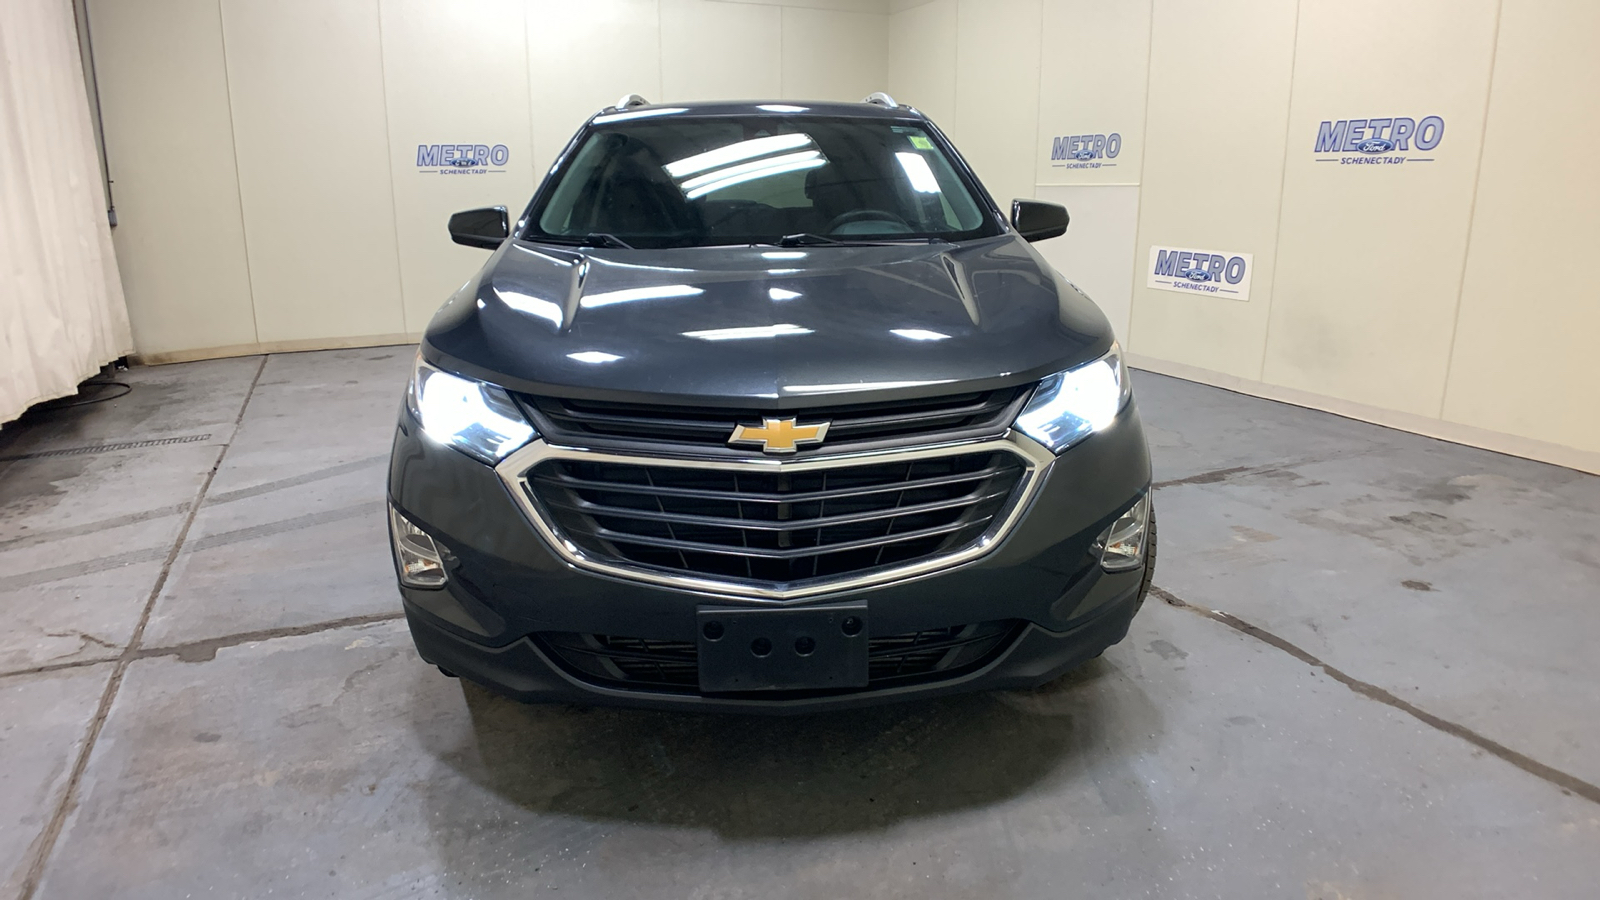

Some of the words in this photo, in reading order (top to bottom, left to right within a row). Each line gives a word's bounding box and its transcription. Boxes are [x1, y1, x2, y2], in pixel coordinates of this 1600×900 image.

[1051, 133, 1122, 160] METRO
[1314, 116, 1445, 152] METRO
[417, 144, 509, 167] METRO
[1154, 250, 1246, 284] METRO
[1173, 281, 1219, 293] SCHENECTADY
